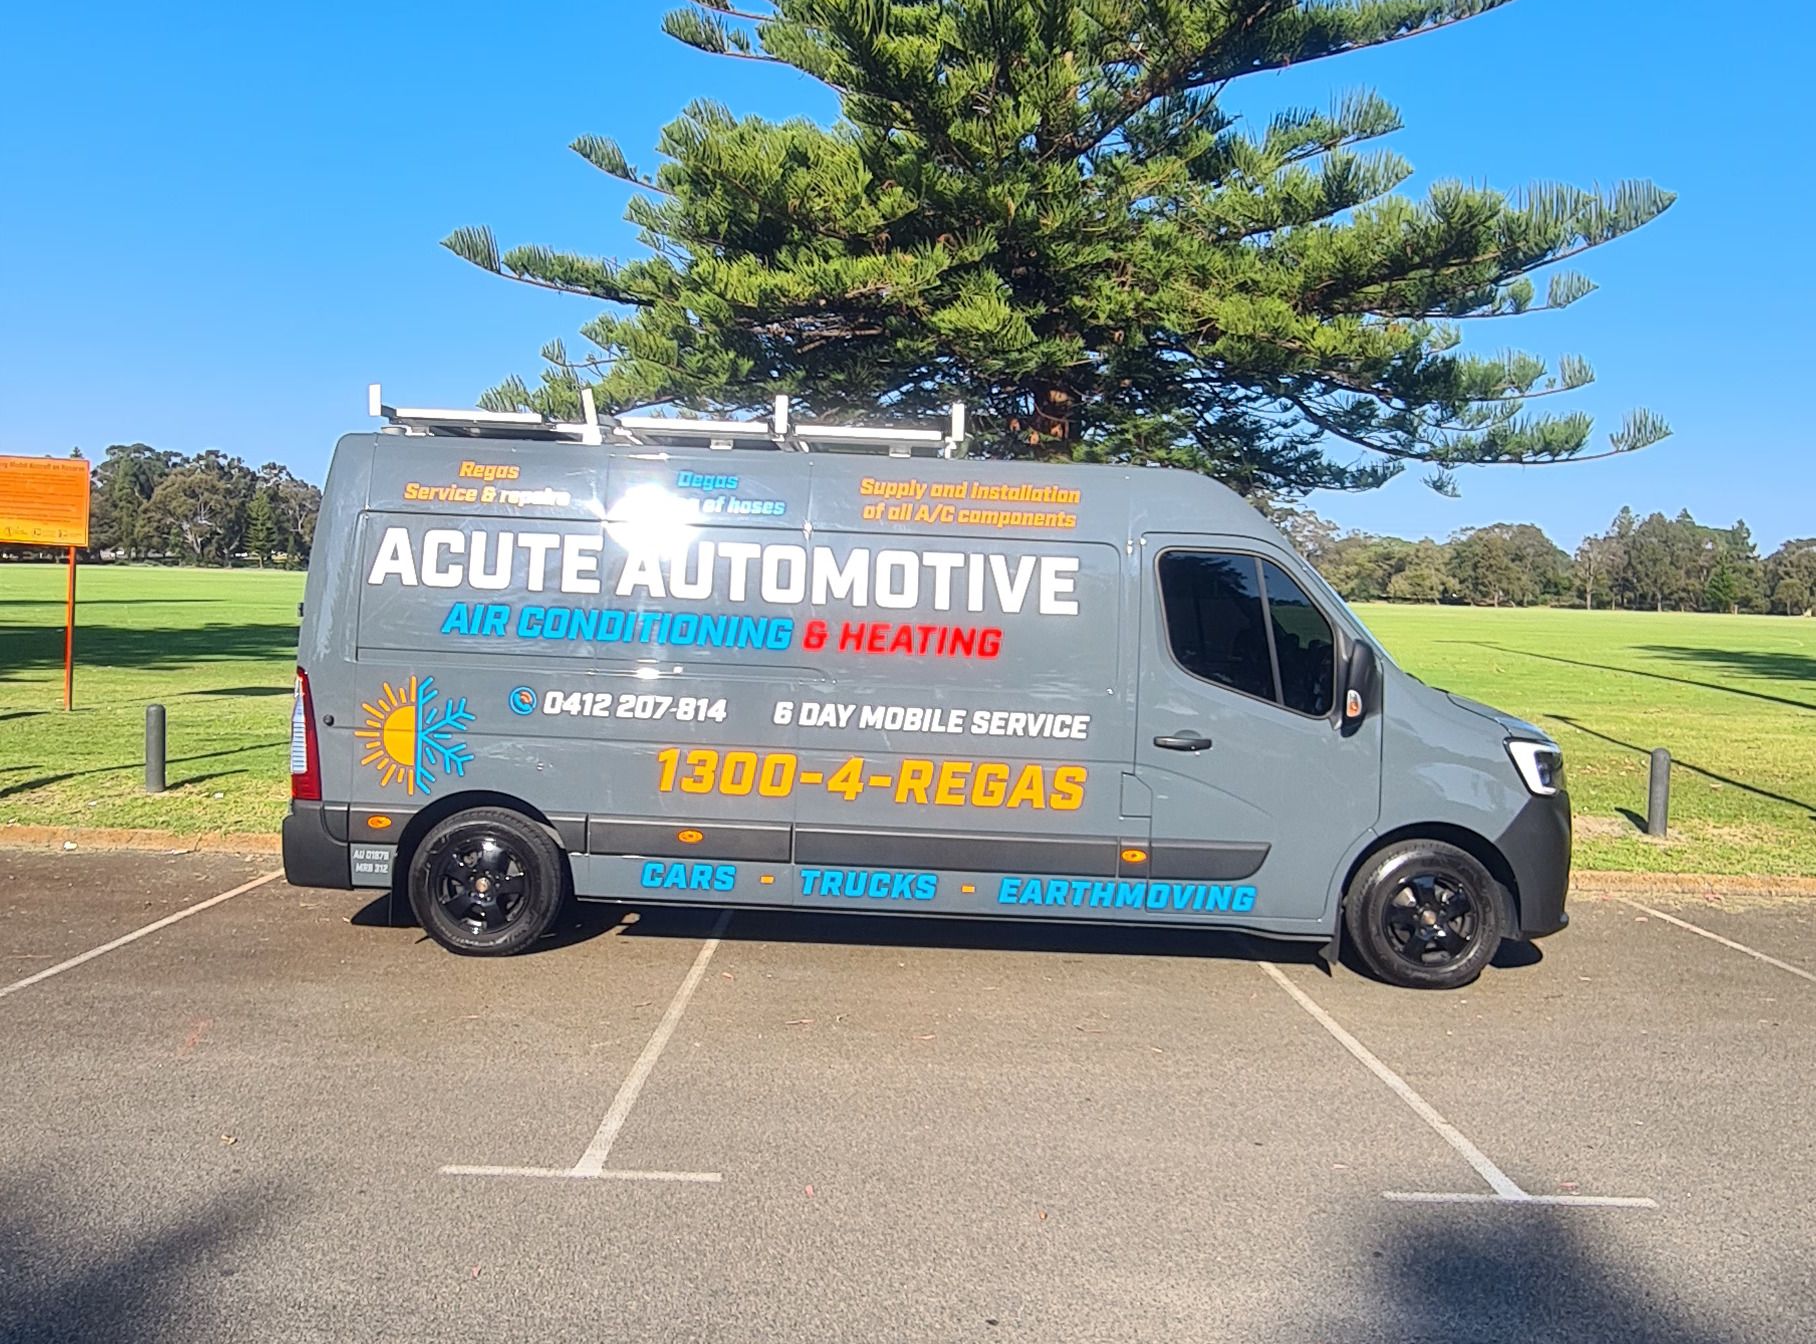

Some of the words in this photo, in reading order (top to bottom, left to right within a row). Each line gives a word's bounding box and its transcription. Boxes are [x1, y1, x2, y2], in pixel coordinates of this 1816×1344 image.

[457, 460, 521, 481] Regas
[677, 470, 740, 491] Degas
[404, 483, 479, 503] Service
[480, 486, 498, 504] &
[859, 477, 928, 501] Supply
[929, 481, 968, 499] and
[970, 482, 1081, 504] installation
[702, 495, 726, 513] of
[727, 496, 787, 516] hoses
[862, 502, 886, 520] of
[887, 504, 914, 522] all
[914, 504, 956, 524] A/C
[957, 508, 1077, 529] components
[366, 526, 606, 594] ACUTE
[615, 540, 1080, 616] AUTOMOTIVE
[441, 602, 511, 637] AIR
[517, 606, 794, 651] CONDITIONING
[803, 620, 829, 651] &
[839, 622, 1003, 659] HEATING
[543, 691, 613, 718] 0412
[615, 694, 728, 723] 207-814
[773, 701, 795, 726] 6
[798, 702, 856, 729] DAY
[858, 706, 967, 734] MOBILE
[970, 710, 1091, 740] SERVICE
[657, 746, 1088, 811] 1300-4-REGAS
[640, 861, 737, 892] CARS
[800, 869, 938, 901] TRUCKS
[998, 877, 1257, 912] EARTHMOVING
